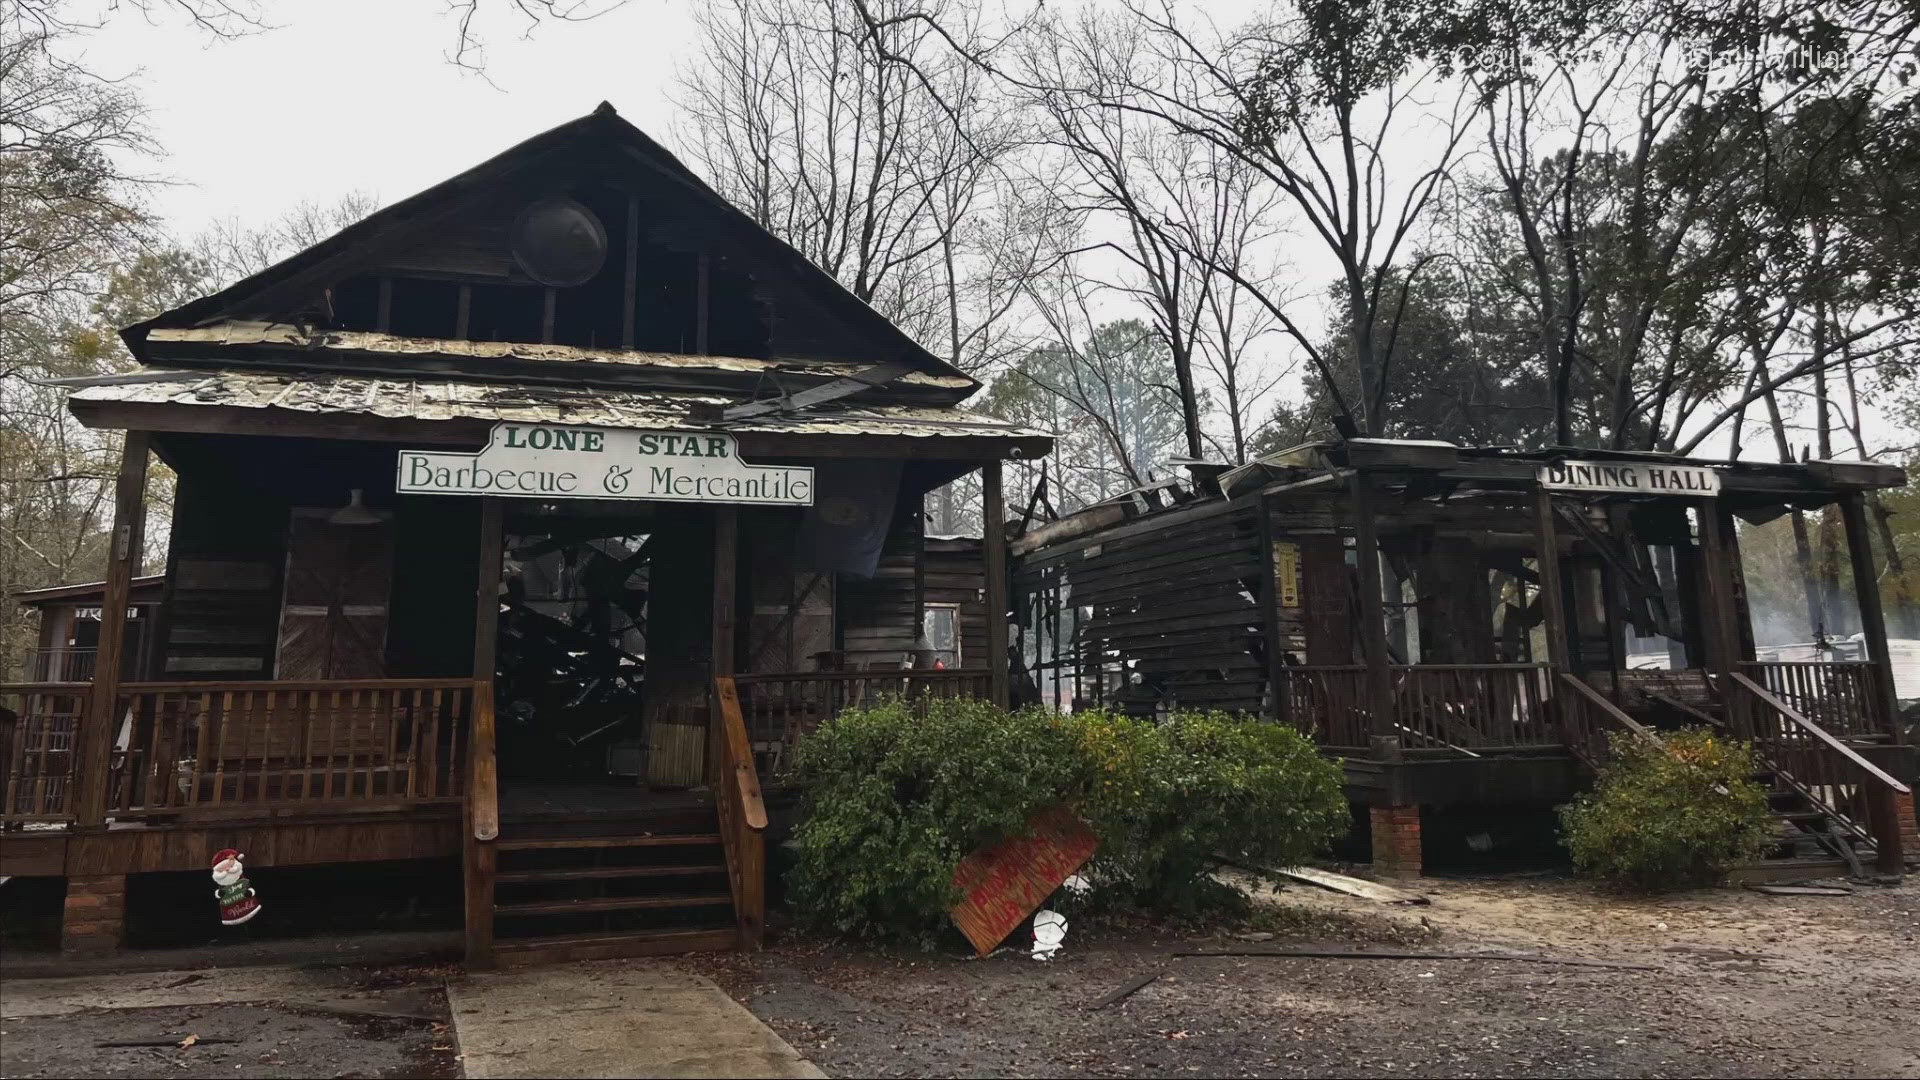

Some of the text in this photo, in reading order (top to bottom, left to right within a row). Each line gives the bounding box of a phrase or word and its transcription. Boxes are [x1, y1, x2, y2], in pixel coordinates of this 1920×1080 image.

[504, 427, 729, 458] LONE STAR
[407, 456, 809, 500] Barbecue & Mercantile
[1550, 465, 1712, 491] DINING HALL
